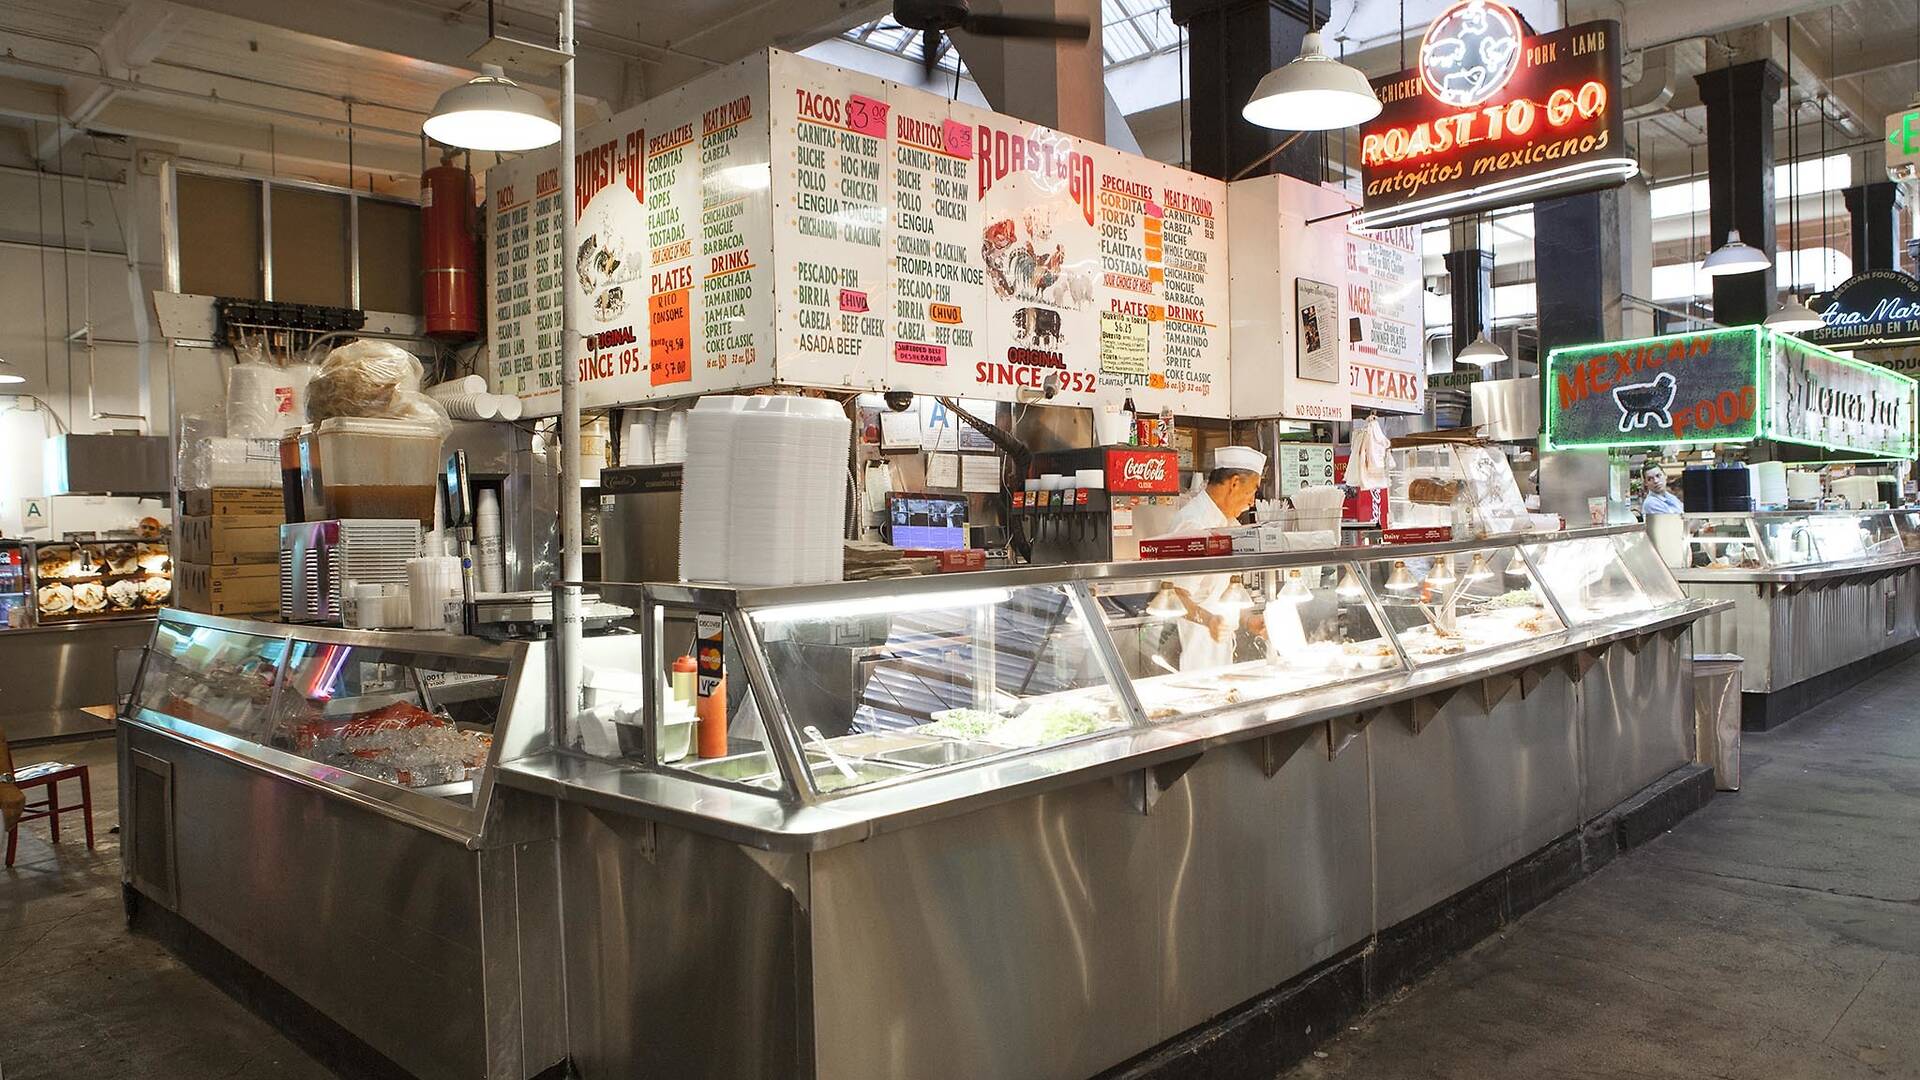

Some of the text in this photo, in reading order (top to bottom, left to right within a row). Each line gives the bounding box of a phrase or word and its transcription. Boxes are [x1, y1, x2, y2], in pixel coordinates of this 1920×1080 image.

[1526, 31, 1606, 68] PORK LAMB
[703, 95, 751, 133] MEAT BY POUND
[796, 88, 840, 123] TACOS
[897, 115, 941, 149] BURRITOS
[1362, 81, 1607, 167] ROAST TO GO
[649, 123, 693, 154] SPECIALTIES
[702, 125, 738, 150] CARNITAS
[797, 123, 878, 158] CARNITAS PORK BEEF
[648, 148, 683, 175] GORDITAS
[702, 146, 731, 164] CABEZA
[797, 146, 880, 181] BUCHE HOG MAW
[897, 146, 967, 179] CARNITAS PORK BEEF
[1367, 129, 1609, 198] antojitos mexicanos
[575, 138, 618, 228] ROAST
[626, 128, 645, 205] GO
[649, 170, 676, 193] TORTAS
[797, 170, 878, 203] POLLO CHICKEN
[897, 169, 968, 201] BUCHE HOG MAW
[978, 125, 1054, 202] ROAST
[1069, 152, 1095, 227] GO
[1102, 174, 1153, 200] SPECIALTIES
[648, 190, 670, 211] SOPES
[797, 192, 882, 229] LENGUA TONGUE
[897, 191, 967, 222] POLLO CHICKEN
[1101, 192, 1147, 216] GORDITAS
[1164, 188, 1213, 217] MEAT BY POUND
[648, 207, 679, 231] FLAUTAS
[703, 202, 744, 225] CHICHARRON
[897, 213, 934, 235] LENGUA
[1101, 208, 1135, 228] TORTAS
[1164, 208, 1201, 226] CARNITAS
[649, 224, 685, 248] TOSTADAS
[704, 220, 734, 240] TONGUE
[799, 216, 881, 248] CHICHARRON CRACKLING
[1101, 224, 1128, 241] SOPES
[1164, 220, 1193, 236] CABEZA
[1164, 232, 1187, 246] BUCHE
[704, 234, 745, 256] BARBACOA
[897, 235, 967, 264] CHICHARRON CRACKLING
[1101, 240, 1142, 260] FLAUTAS
[1164, 244, 1208, 263] WHOLE CHICKEN
[712, 249, 750, 274] DRINKS
[896, 256, 984, 286] TROMPA PORK NOSE
[1102, 256, 1149, 278] TOSTADAS
[652, 265, 692, 295] PLATES
[704, 270, 752, 293] HORCHATA
[798, 262, 858, 288] PESCADO FISH
[1164, 267, 1205, 284] CHICHARRON
[1165, 280, 1195, 293] TONGUE
[1832, 272, 1919, 300] MEXICAN FOOD TO GO
[658, 293, 677, 308] RICO
[704, 286, 753, 308] TAMARINDO
[799, 285, 868, 309] BIRRIA CHIVO
[897, 278, 951, 303] PESCADO FISH
[1165, 292, 1205, 307] BARBACOA
[653, 307, 684, 325] CONSOME
[705, 304, 746, 326] JAMAICA
[897, 300, 958, 321] BIRRIA CHIVO
[1112, 299, 1149, 318] PLATES
[1168, 305, 1204, 323] DRINKS
[1820, 302, 1862, 326] Ana
[706, 322, 732, 339] SPRITE
[799, 310, 885, 338] CABEZA BEEF CHEEK
[897, 321, 974, 348] CABEZA BEEF CHEEK
[1115, 322, 1132, 334] $6.25
[1166, 322, 1207, 336] HORCHATA
[1384, 322, 1399, 335] Choice
[1400, 326, 1405, 336] of
[1813, 322, 1883, 340] ESPECIALIDAD
[1888, 322, 1901, 334] EN
[706, 334, 754, 354] COKE CLASSIC
[799, 334, 862, 356] ASADA BEEF
[1166, 332, 1209, 348] TAMARINDO
[1166, 344, 1201, 358] JAMAICA
[578, 353, 614, 382] SINCE
[1007, 346, 1067, 370] ORIGINAL
[1166, 356, 1191, 369] SPRITE
[976, 361, 1042, 388] SINCE
[1124, 373, 1149, 387] PLATE
[1166, 369, 1211, 384] COKE CLASSIC
[1364, 368, 1418, 401] YEARS
[1558, 336, 1757, 440] MEXICAN FOOD
[929, 401, 949, 428] A
[1296, 404, 1343, 419] NO FOOD STAMPS
[1124, 458, 1165, 481] Coca-Cola
[28, 503, 42, 517] A
[1141, 545, 1159, 553] Daisy
[700, 620, 721, 629] DISCOVER
